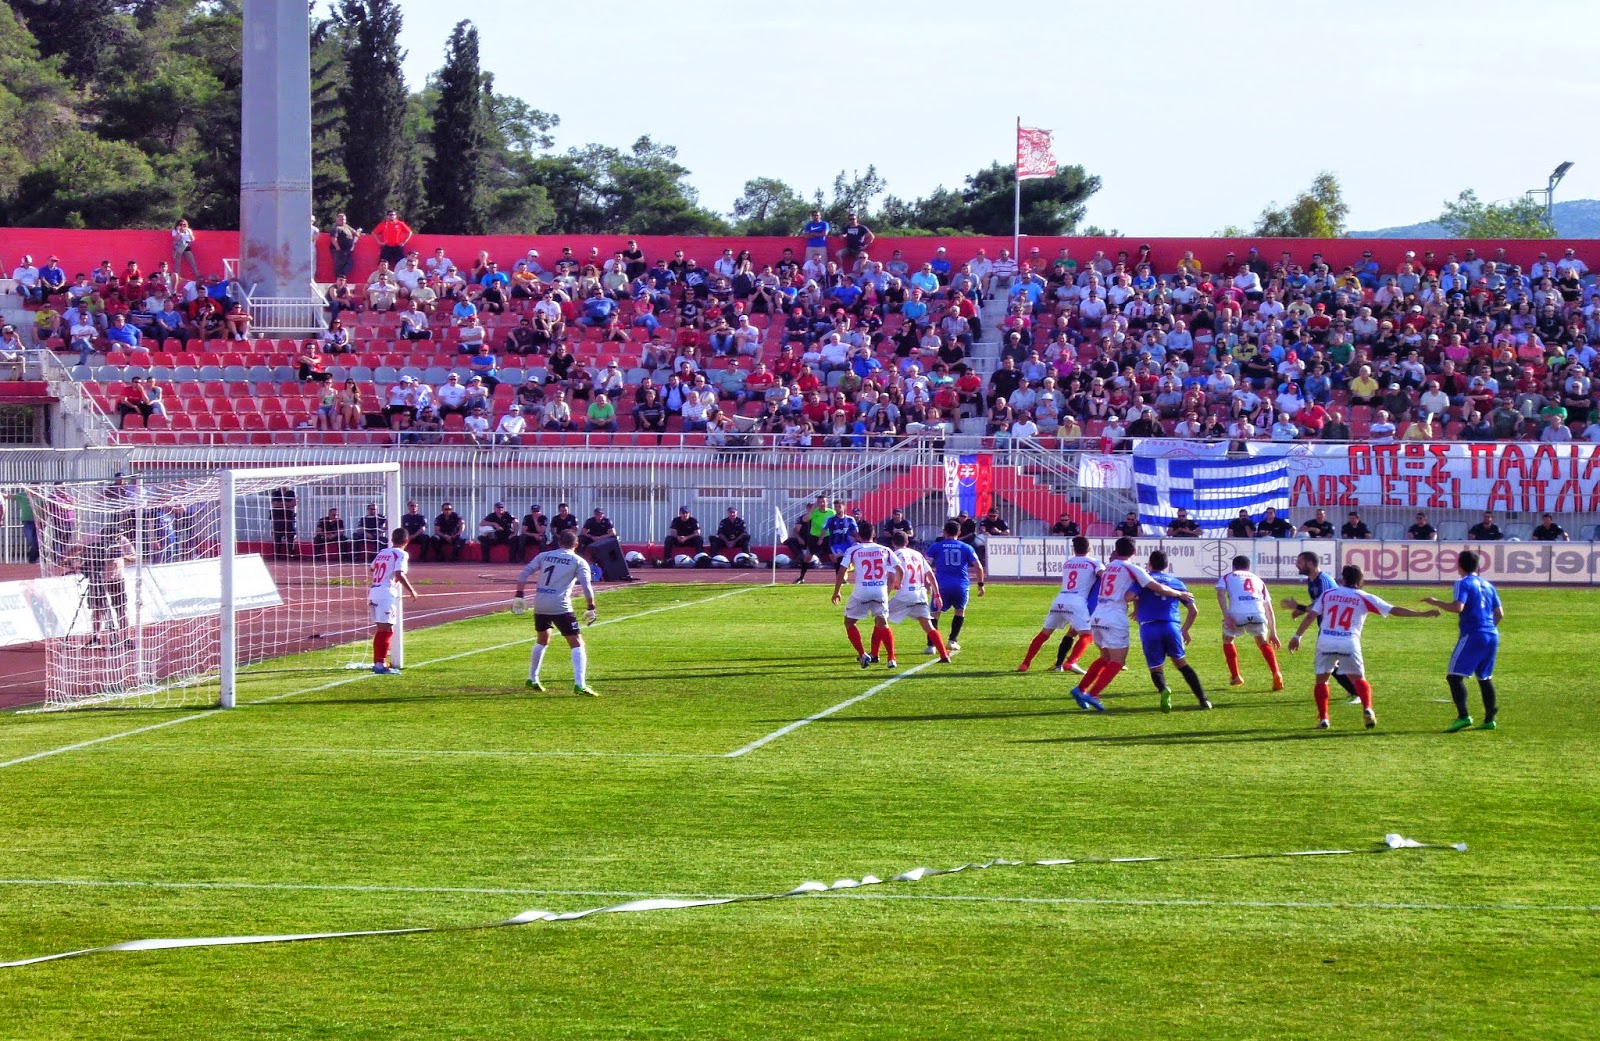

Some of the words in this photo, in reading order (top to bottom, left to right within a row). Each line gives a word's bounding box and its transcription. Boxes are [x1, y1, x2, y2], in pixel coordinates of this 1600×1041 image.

[1381, 475, 1461, 508] ΕΤΣΙ
[943, 549, 962, 566] 10
[543, 564, 555, 586] 1
[861, 559, 884, 580] 25
[906, 563, 924, 585] 21
[1066, 570, 1078, 590] 8
[1100, 574, 1117, 597] 13
[1243, 578, 1254, 593] 4
[1327, 604, 1355, 631] 14
